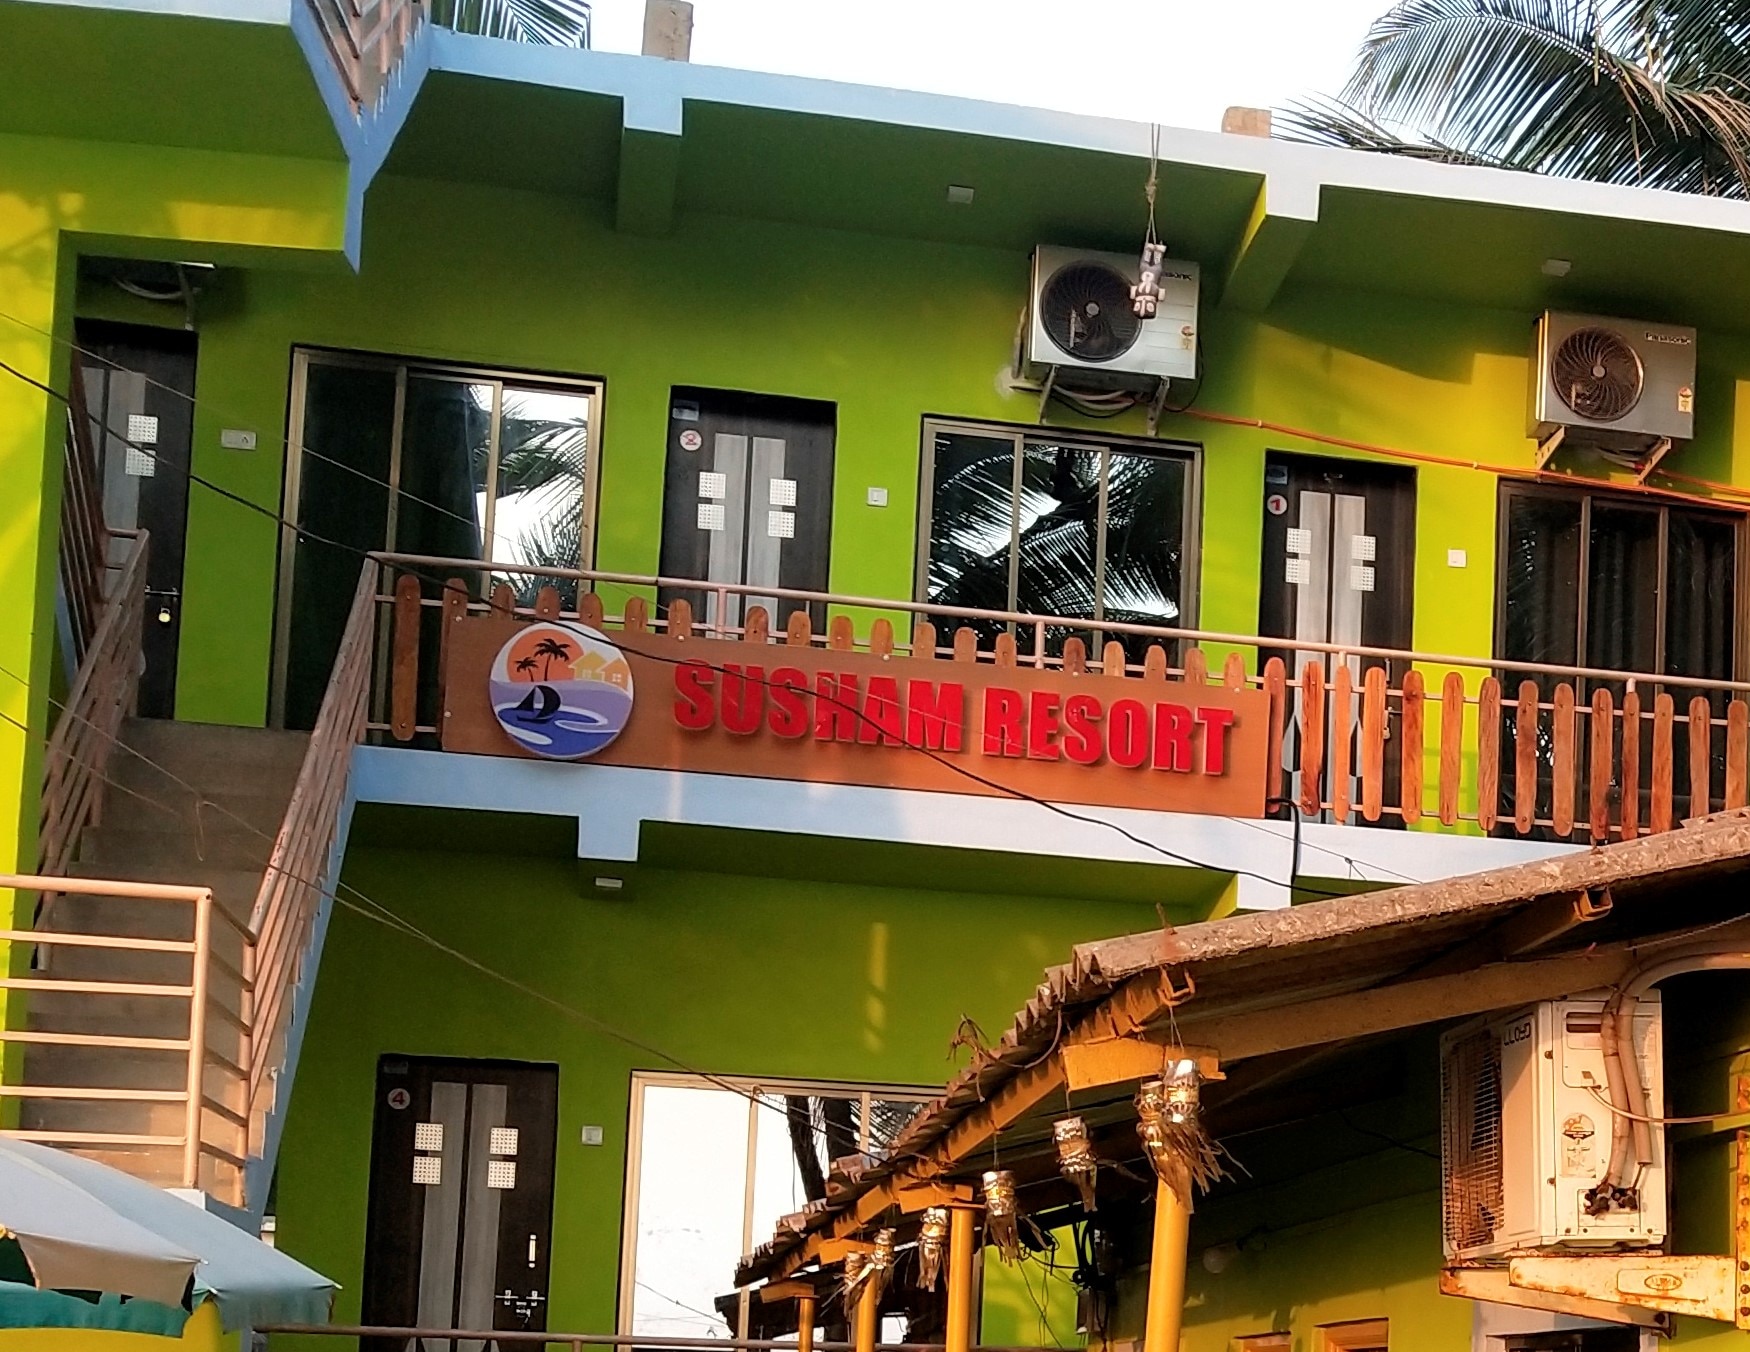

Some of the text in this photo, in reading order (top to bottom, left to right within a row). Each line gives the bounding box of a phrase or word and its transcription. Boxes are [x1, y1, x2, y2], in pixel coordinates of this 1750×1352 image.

[673, 658, 1235, 776] SUSHAM RESORT
[392, 1091, 405, 1106] 4
